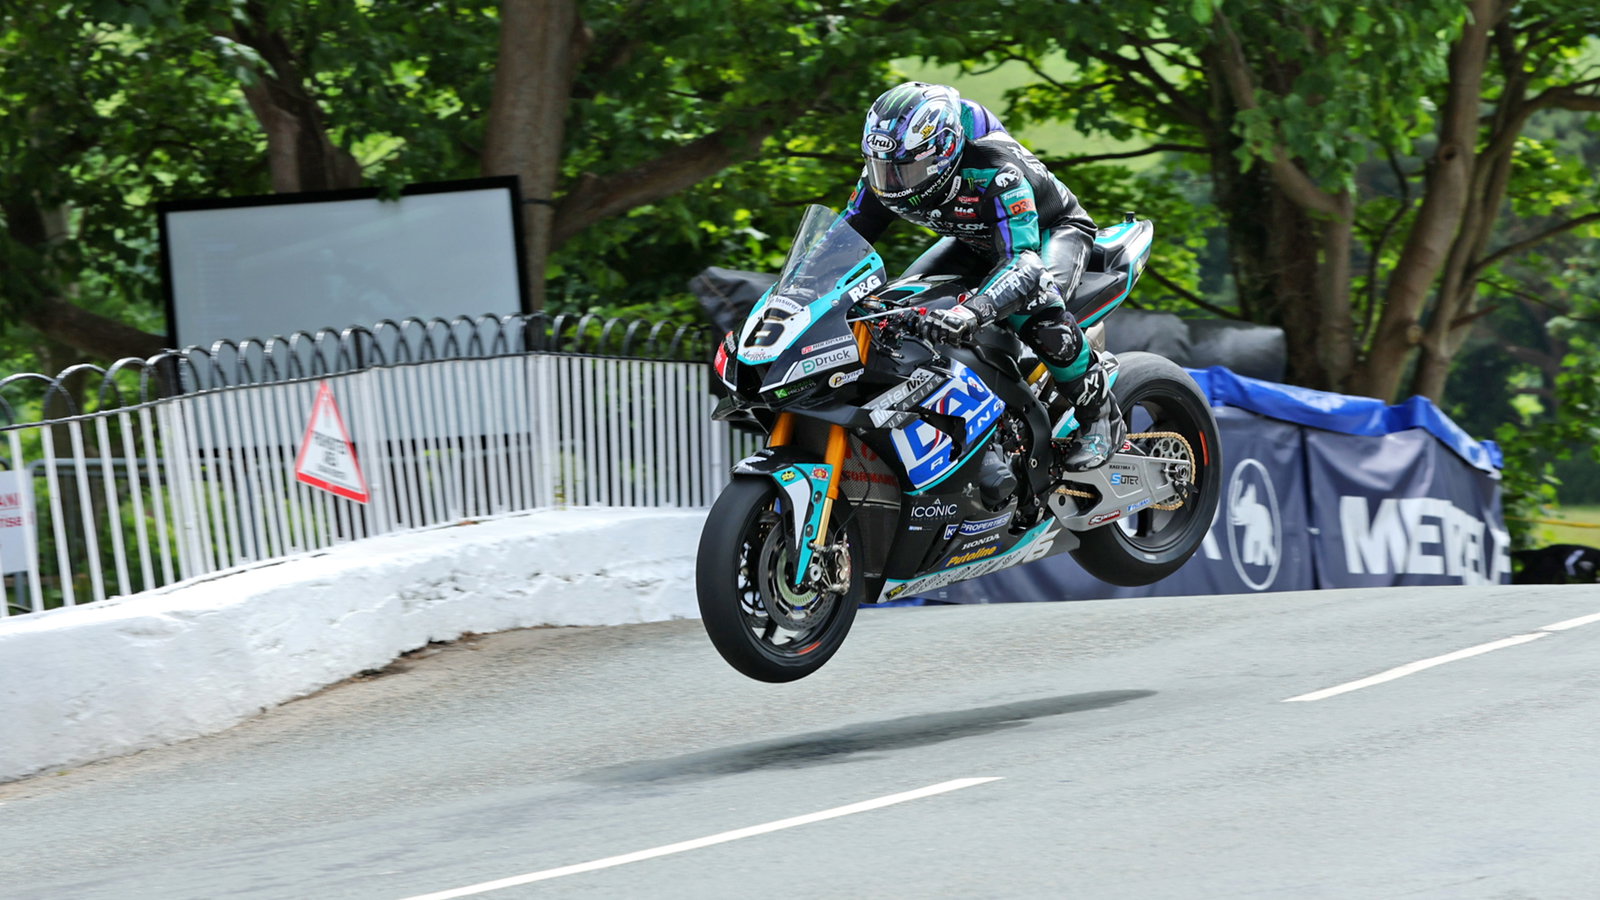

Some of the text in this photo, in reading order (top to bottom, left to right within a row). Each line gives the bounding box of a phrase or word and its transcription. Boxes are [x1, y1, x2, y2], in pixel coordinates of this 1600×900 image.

[867, 135, 891, 148] Arai
[848, 275, 882, 303] R&G
[815, 349, 851, 367] Druck
[931, 401, 1006, 471] RING
[911, 503, 958, 519] ICONIC
[962, 533, 1000, 550] HONDA
[946, 545, 998, 567] Putoline
